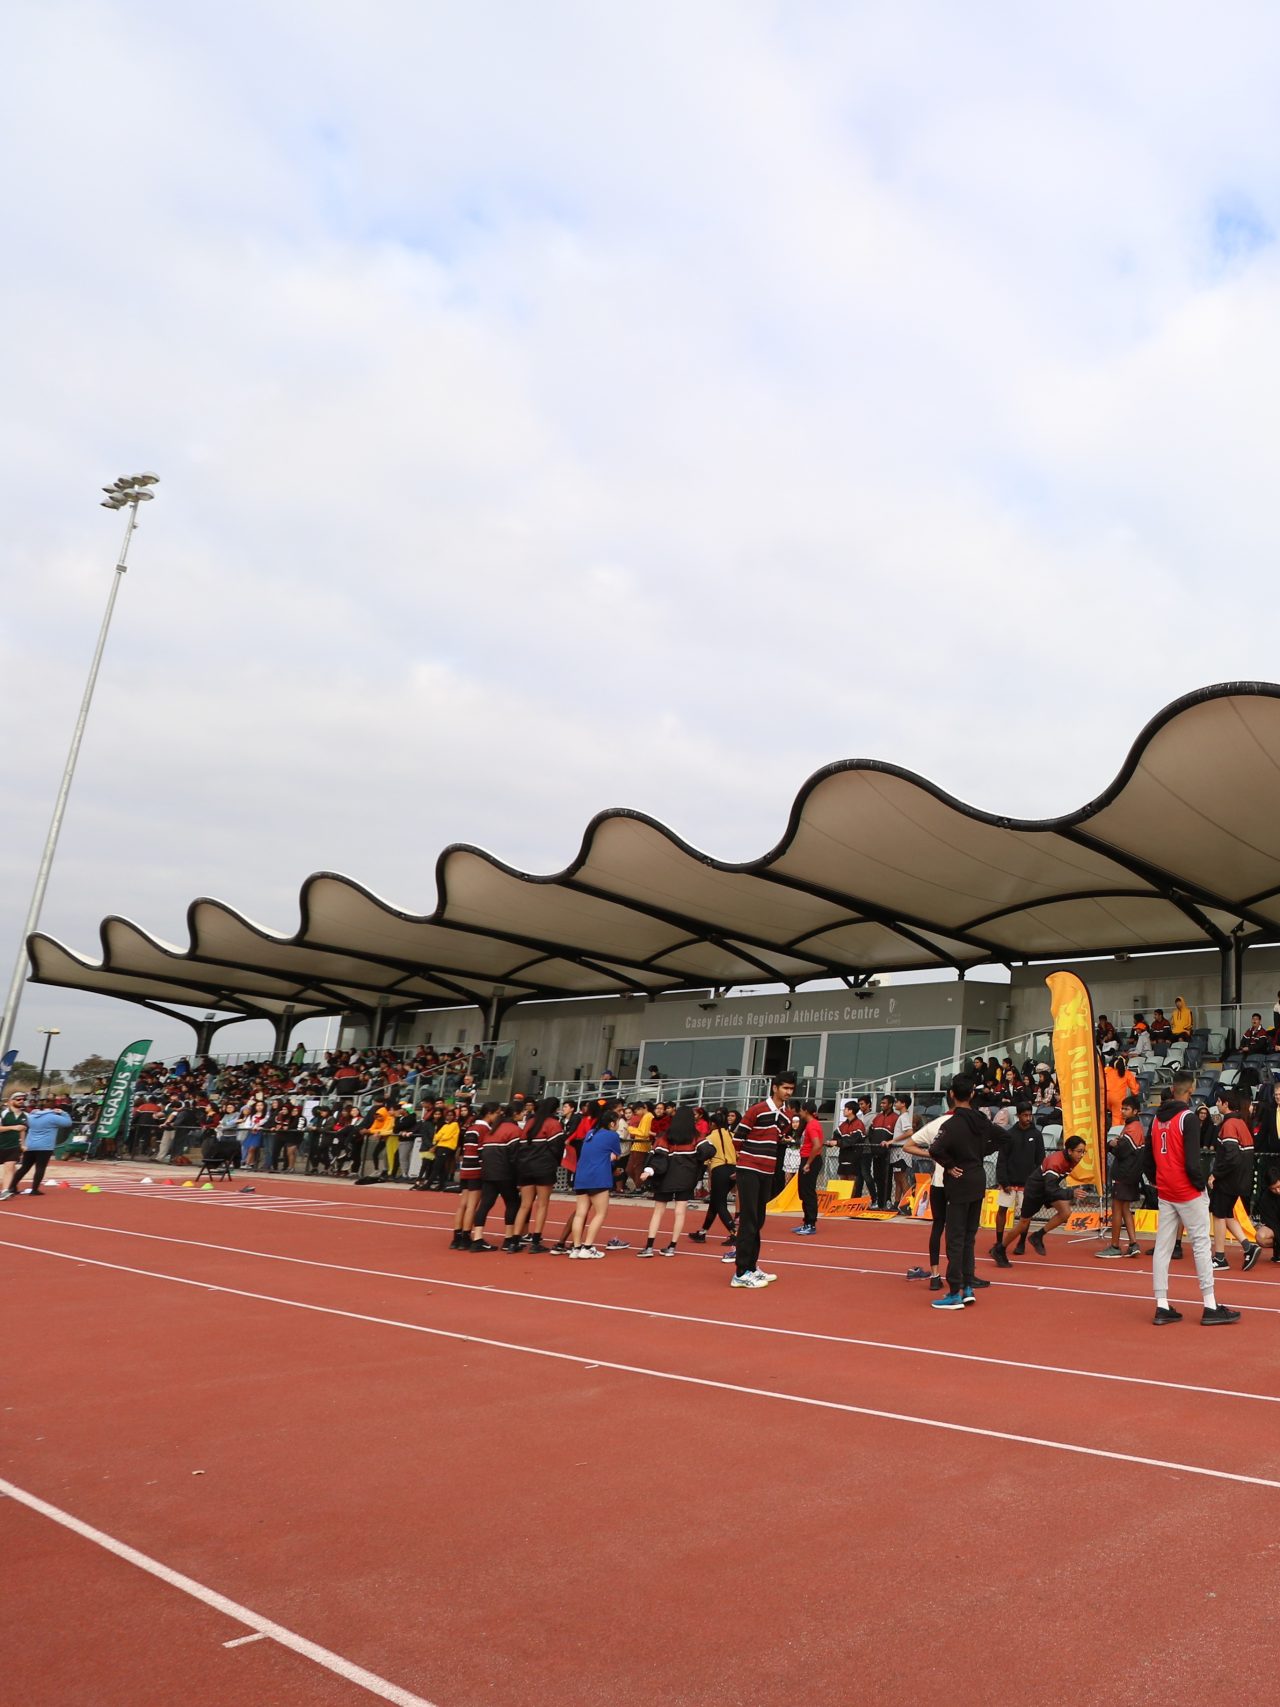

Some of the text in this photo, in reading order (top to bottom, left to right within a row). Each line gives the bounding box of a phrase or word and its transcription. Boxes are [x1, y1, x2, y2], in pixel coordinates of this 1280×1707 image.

[685, 1006, 880, 1030] Casey Fields Regional Athletics Centre
[97, 1071, 131, 1134] PEGASUS
[1068, 1045, 1095, 1172] GRIFFIN
[1160, 1131, 1167, 1154] 1
